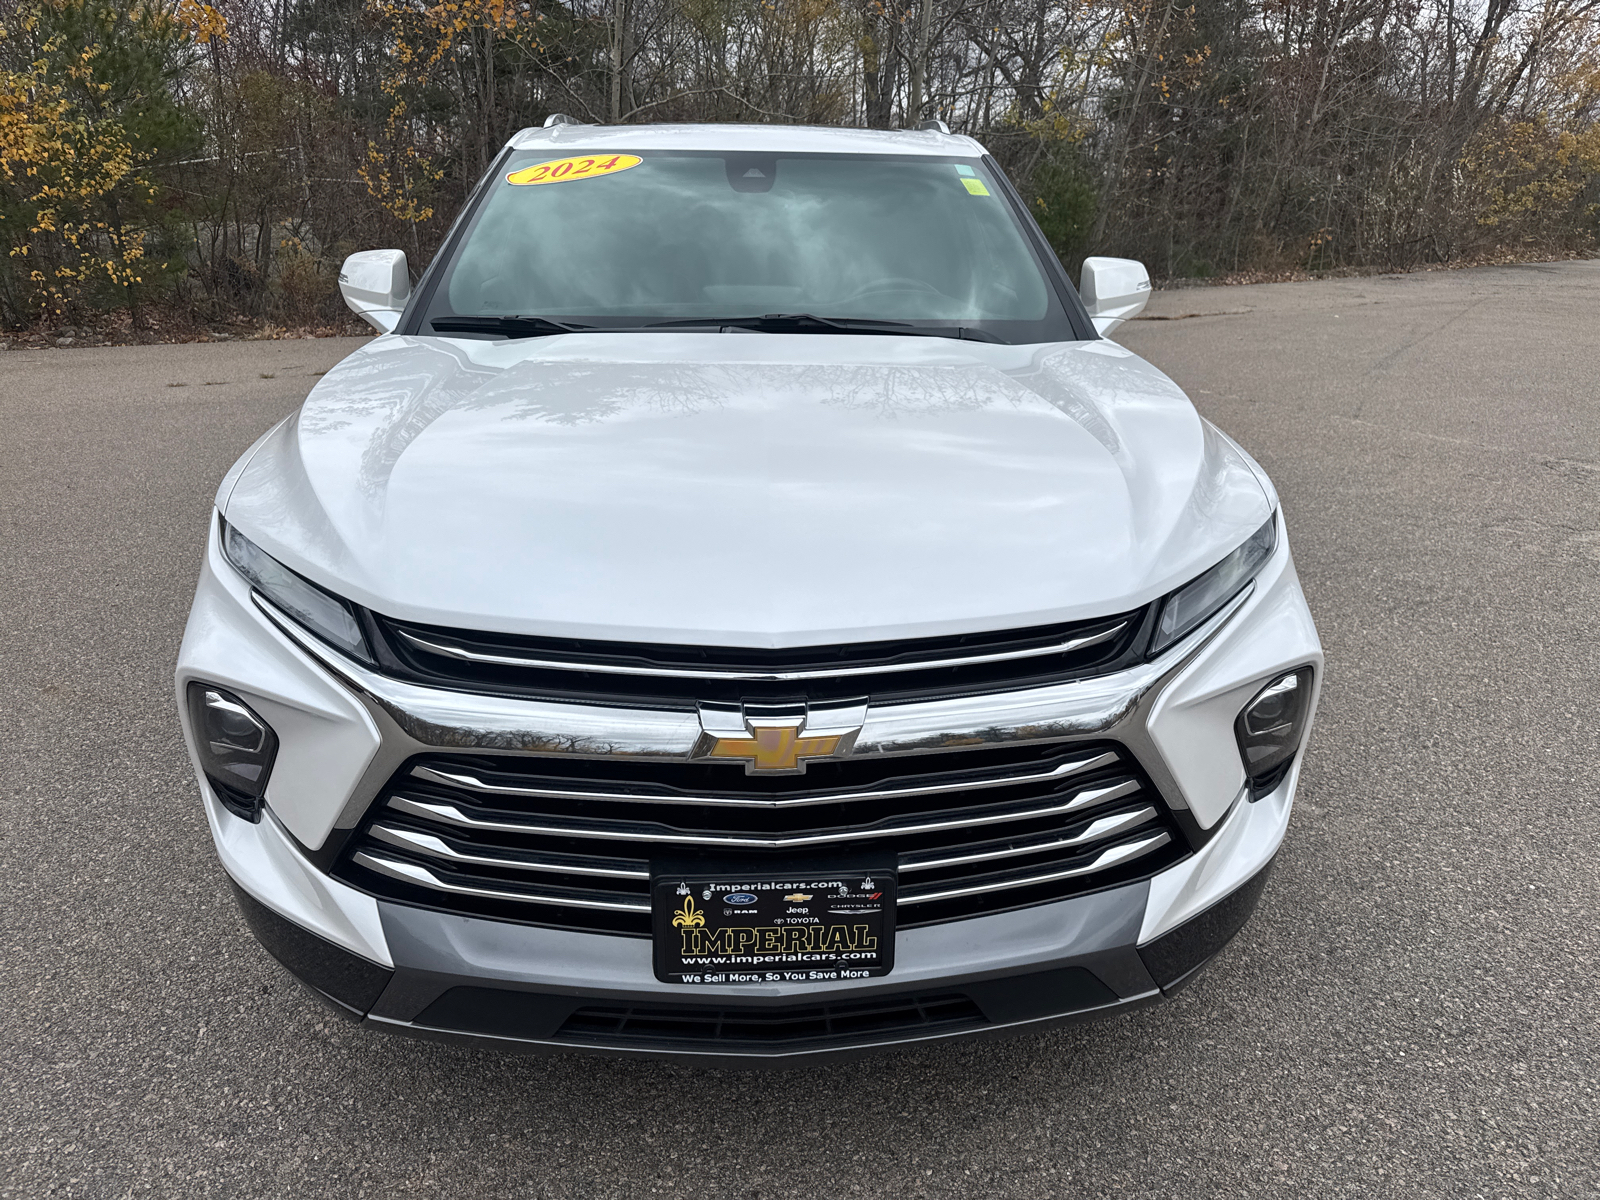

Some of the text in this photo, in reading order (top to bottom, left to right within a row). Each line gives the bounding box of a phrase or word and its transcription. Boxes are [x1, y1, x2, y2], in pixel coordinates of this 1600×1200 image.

[526, 155, 621, 183] 2024
[709, 881, 842, 892] Imperialcars.com
[731, 895, 750, 903] Ford
[786, 907, 809, 915] Jeep
[681, 924, 878, 956] IMPERIAL
[681, 952, 877, 965] www.imperialcars.com
[681, 970, 870, 983] We Sell More, So You Save More
